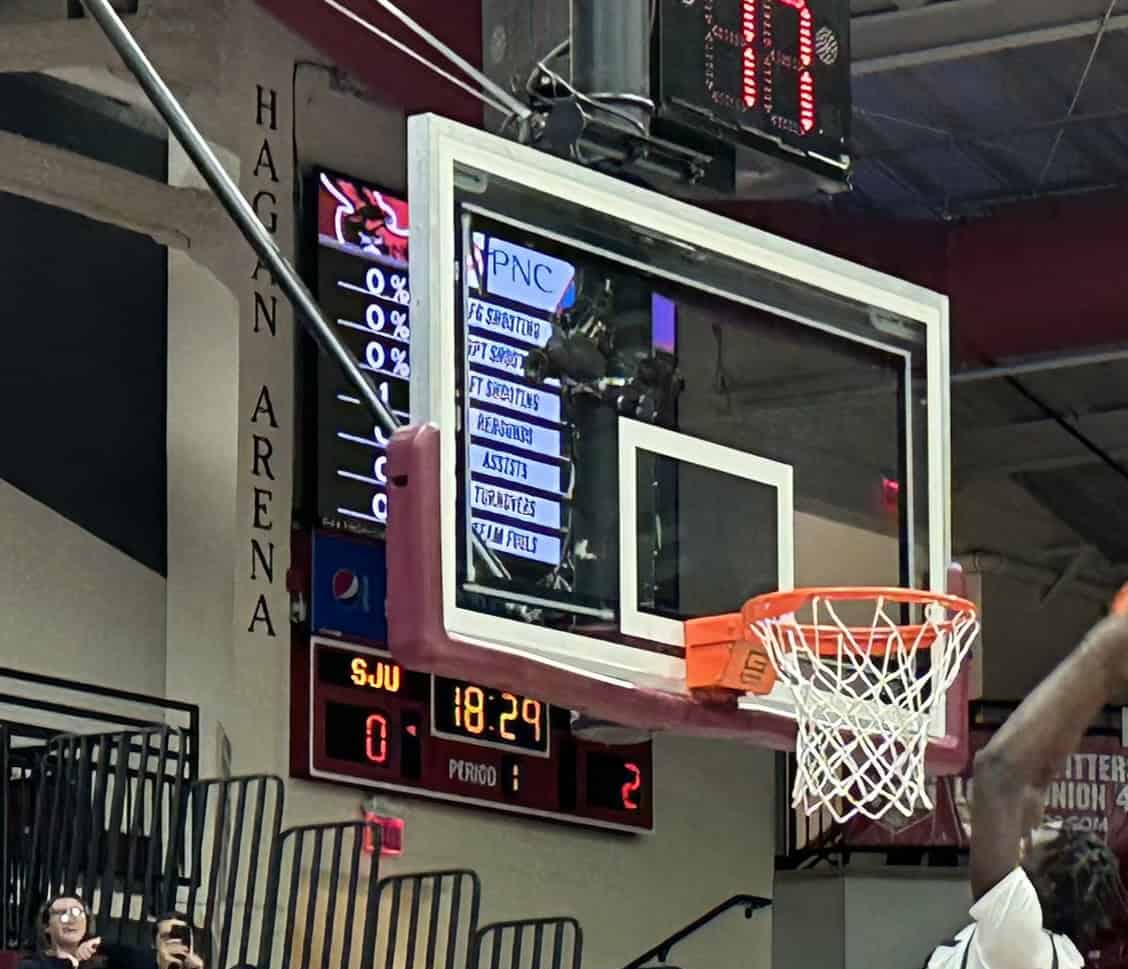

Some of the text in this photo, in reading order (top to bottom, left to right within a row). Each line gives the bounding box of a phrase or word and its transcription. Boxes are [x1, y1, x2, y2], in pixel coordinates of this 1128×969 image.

[491, 249, 553, 294] PNC
[248, 384, 279, 637] ARENA
[351, 657, 400, 693] SJU
[455, 686, 541, 742] 18:29
[365, 714, 386, 763] 0
[448, 758, 519, 792] PERIOD 1
[621, 763, 641, 809] 2
[1045, 783, 1107, 811] NION
